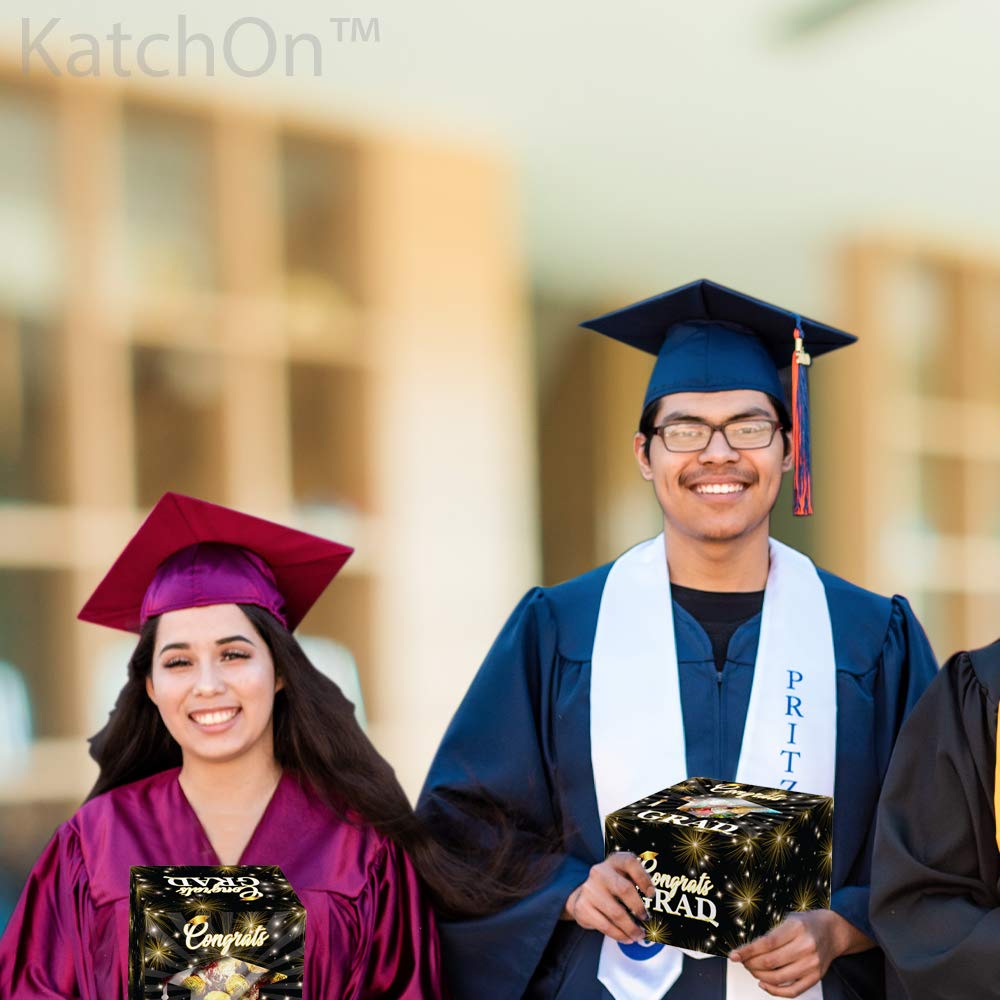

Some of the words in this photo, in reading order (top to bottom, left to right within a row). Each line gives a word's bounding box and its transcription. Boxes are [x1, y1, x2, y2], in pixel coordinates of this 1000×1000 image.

[637, 810, 739, 836] GRAD
[163, 875, 260, 888] GRAD
[176, 884, 263, 900] Congrats
[183, 921, 269, 955] Congrats
